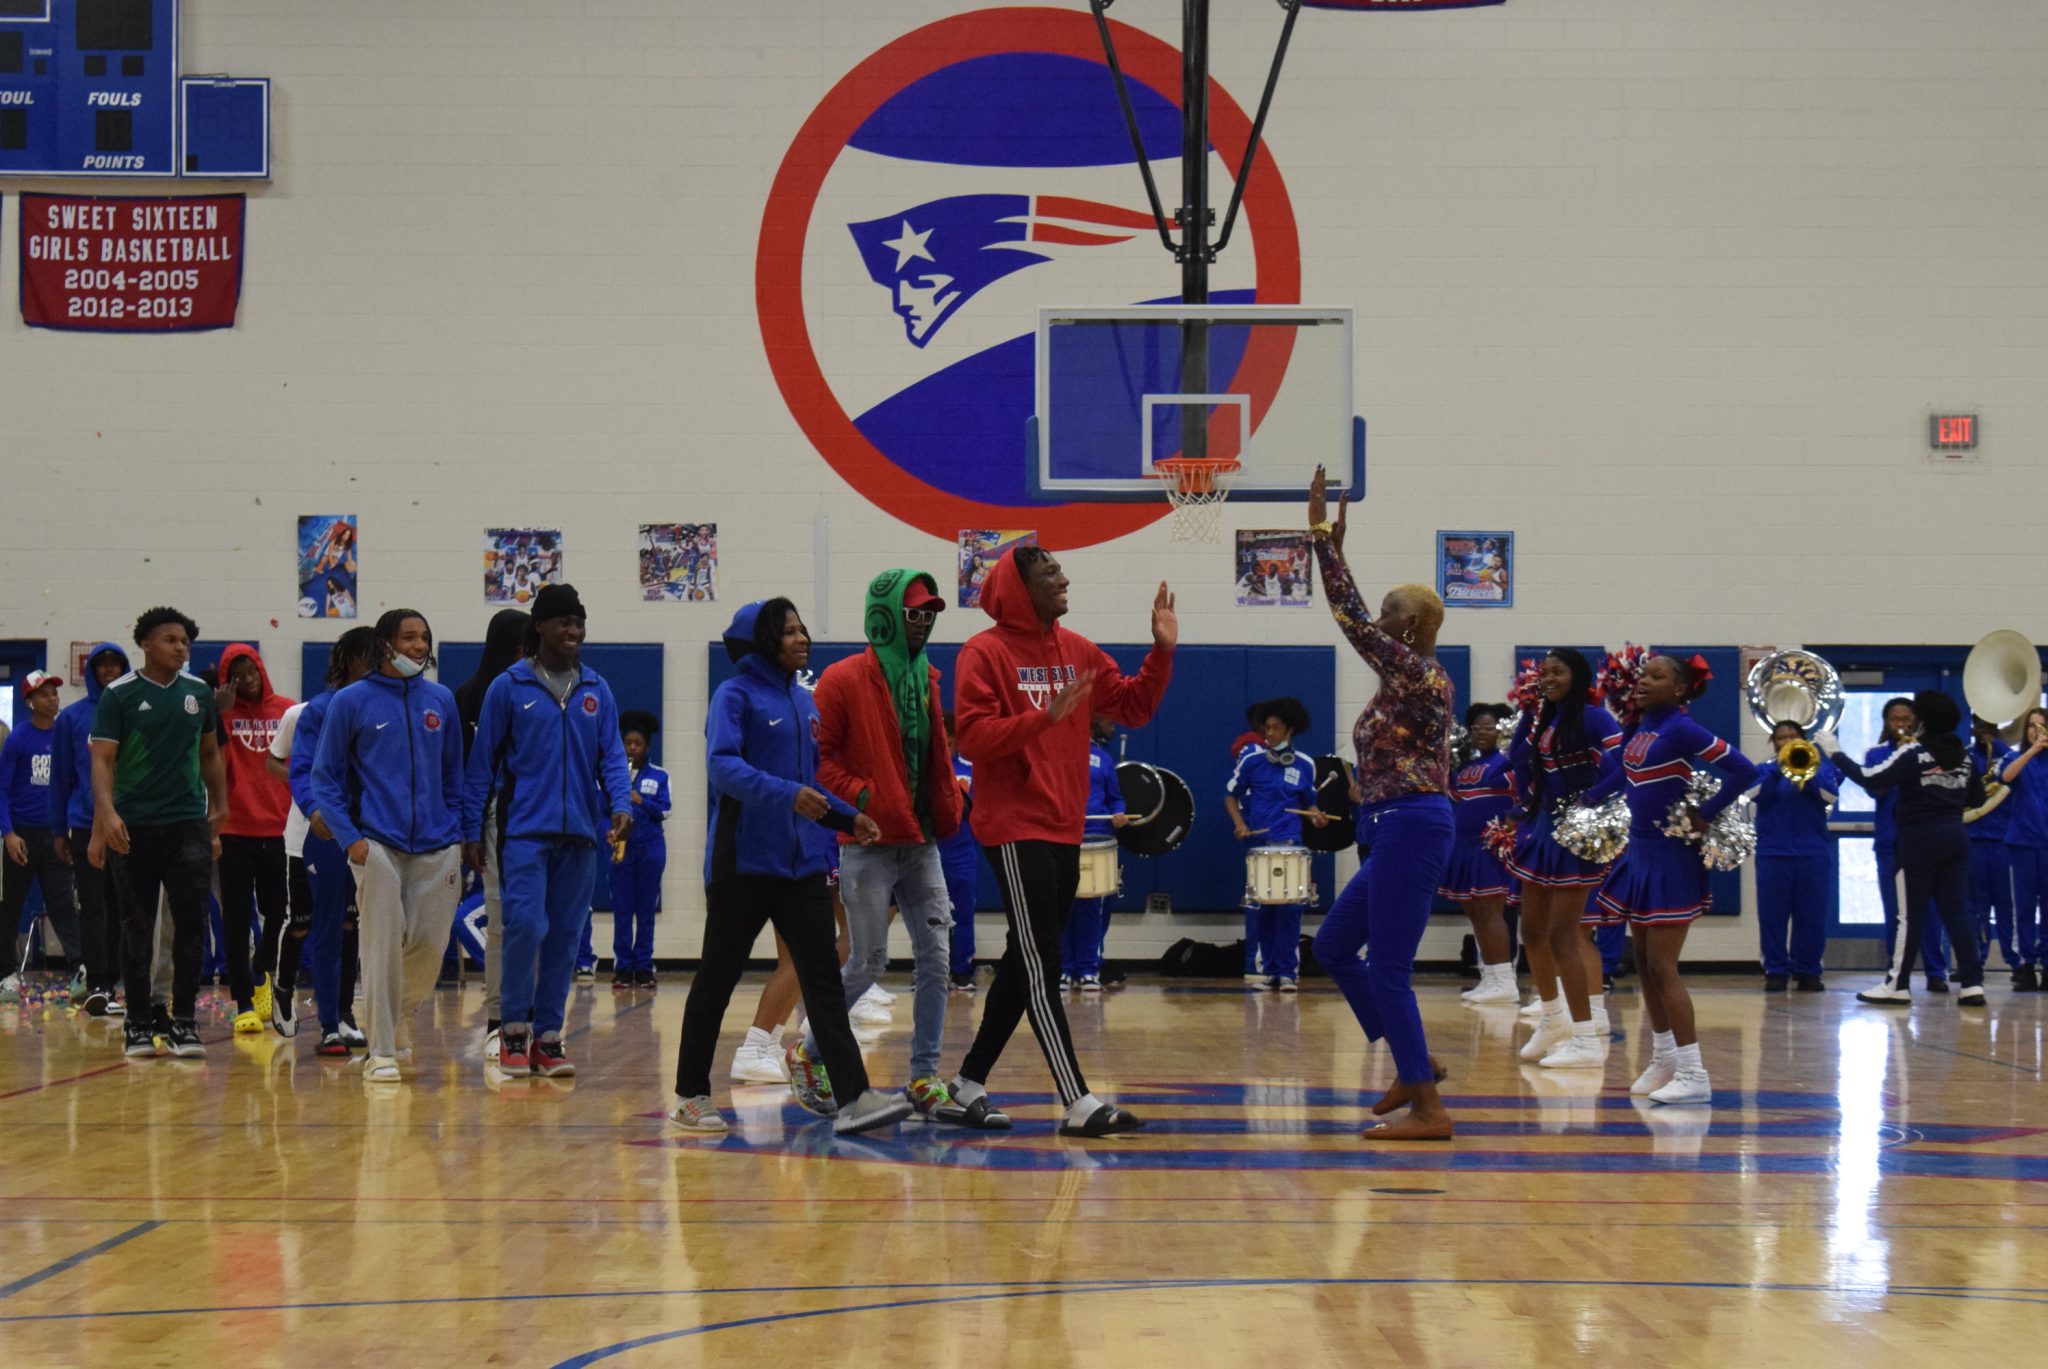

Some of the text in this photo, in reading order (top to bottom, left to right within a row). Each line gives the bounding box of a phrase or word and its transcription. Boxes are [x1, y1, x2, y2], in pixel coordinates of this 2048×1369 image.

[0, 90, 34, 105] OUL
[87, 92, 142, 106] FOULS
[83, 155, 145, 169] POINTS
[48, 205, 218, 231] SWEET SIXTEEN
[29, 235, 232, 263] GIRLS BASKETBALL
[65, 269, 199, 291] 2004-2005
[68, 297, 193, 318] 2012-2013
[1939, 417, 1971, 442] EXIT
